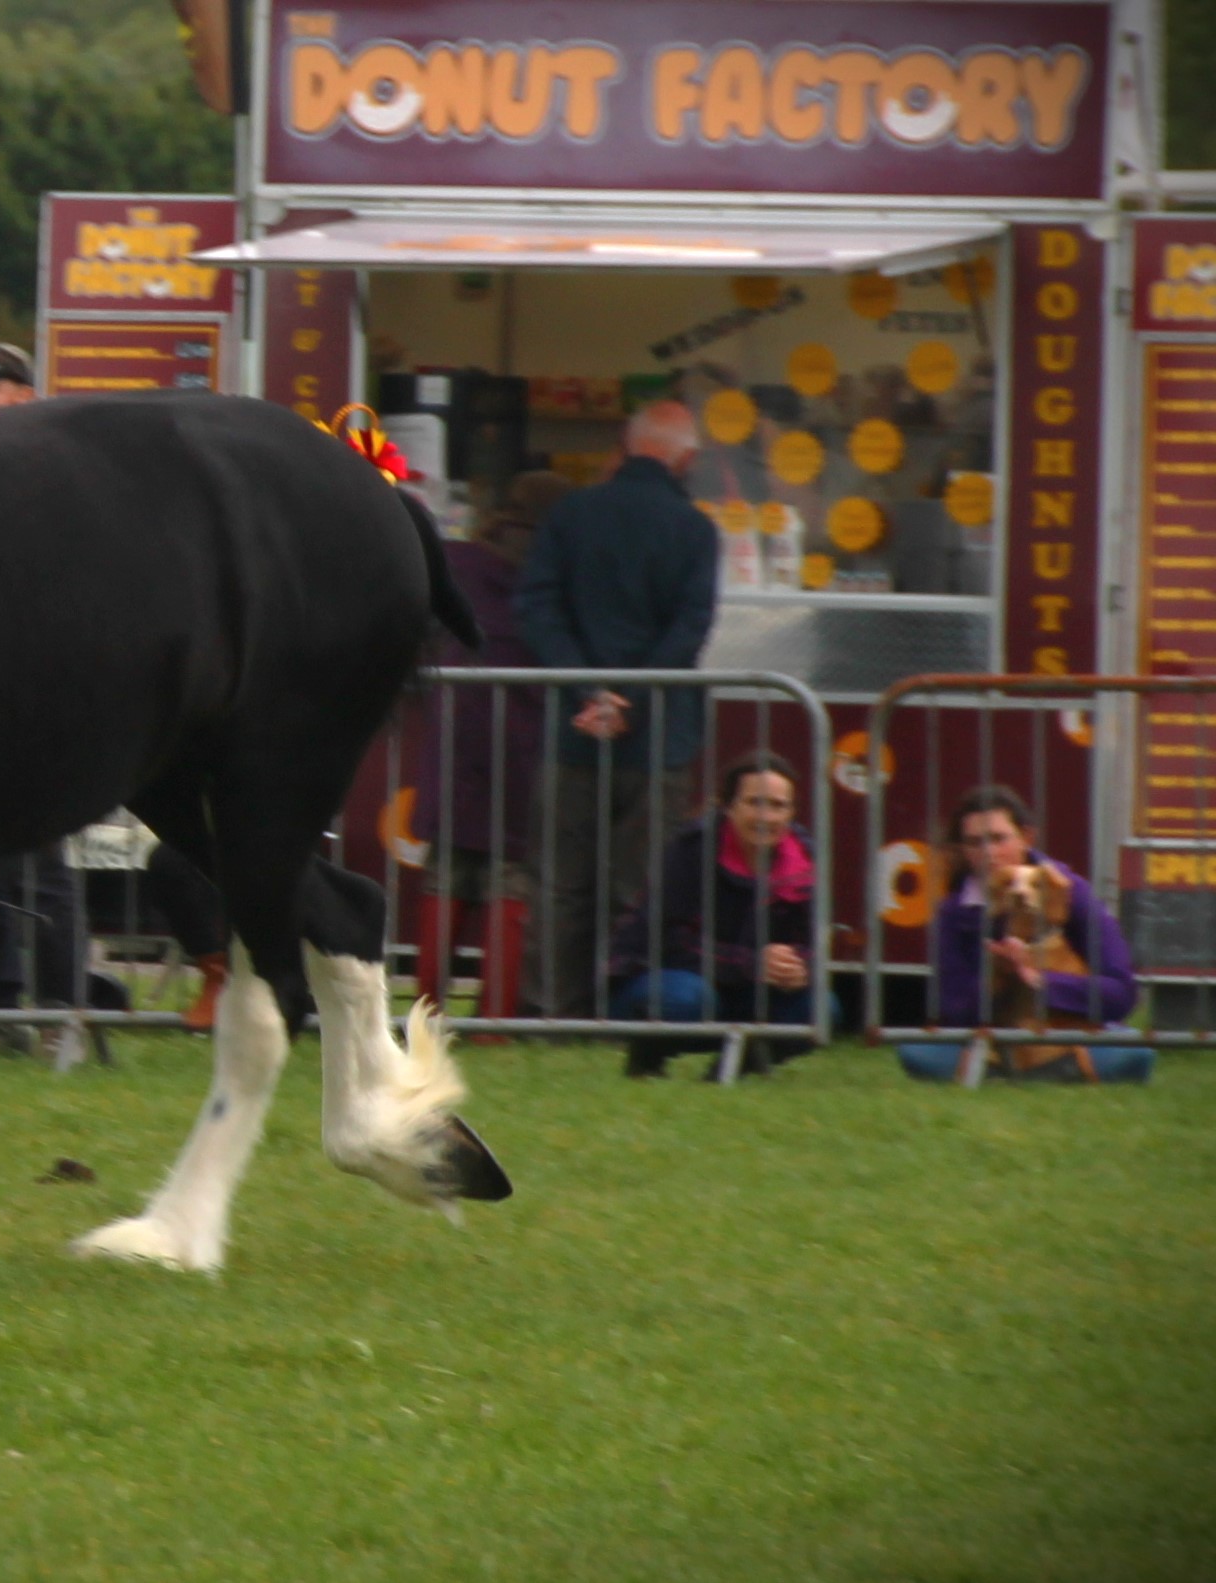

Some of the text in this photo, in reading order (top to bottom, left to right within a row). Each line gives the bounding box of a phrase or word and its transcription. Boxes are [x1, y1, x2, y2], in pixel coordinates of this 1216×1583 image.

[287, 40, 1088, 147] DONUT FACTORY
[1030, 229, 1080, 676] DOUGHNUTS
